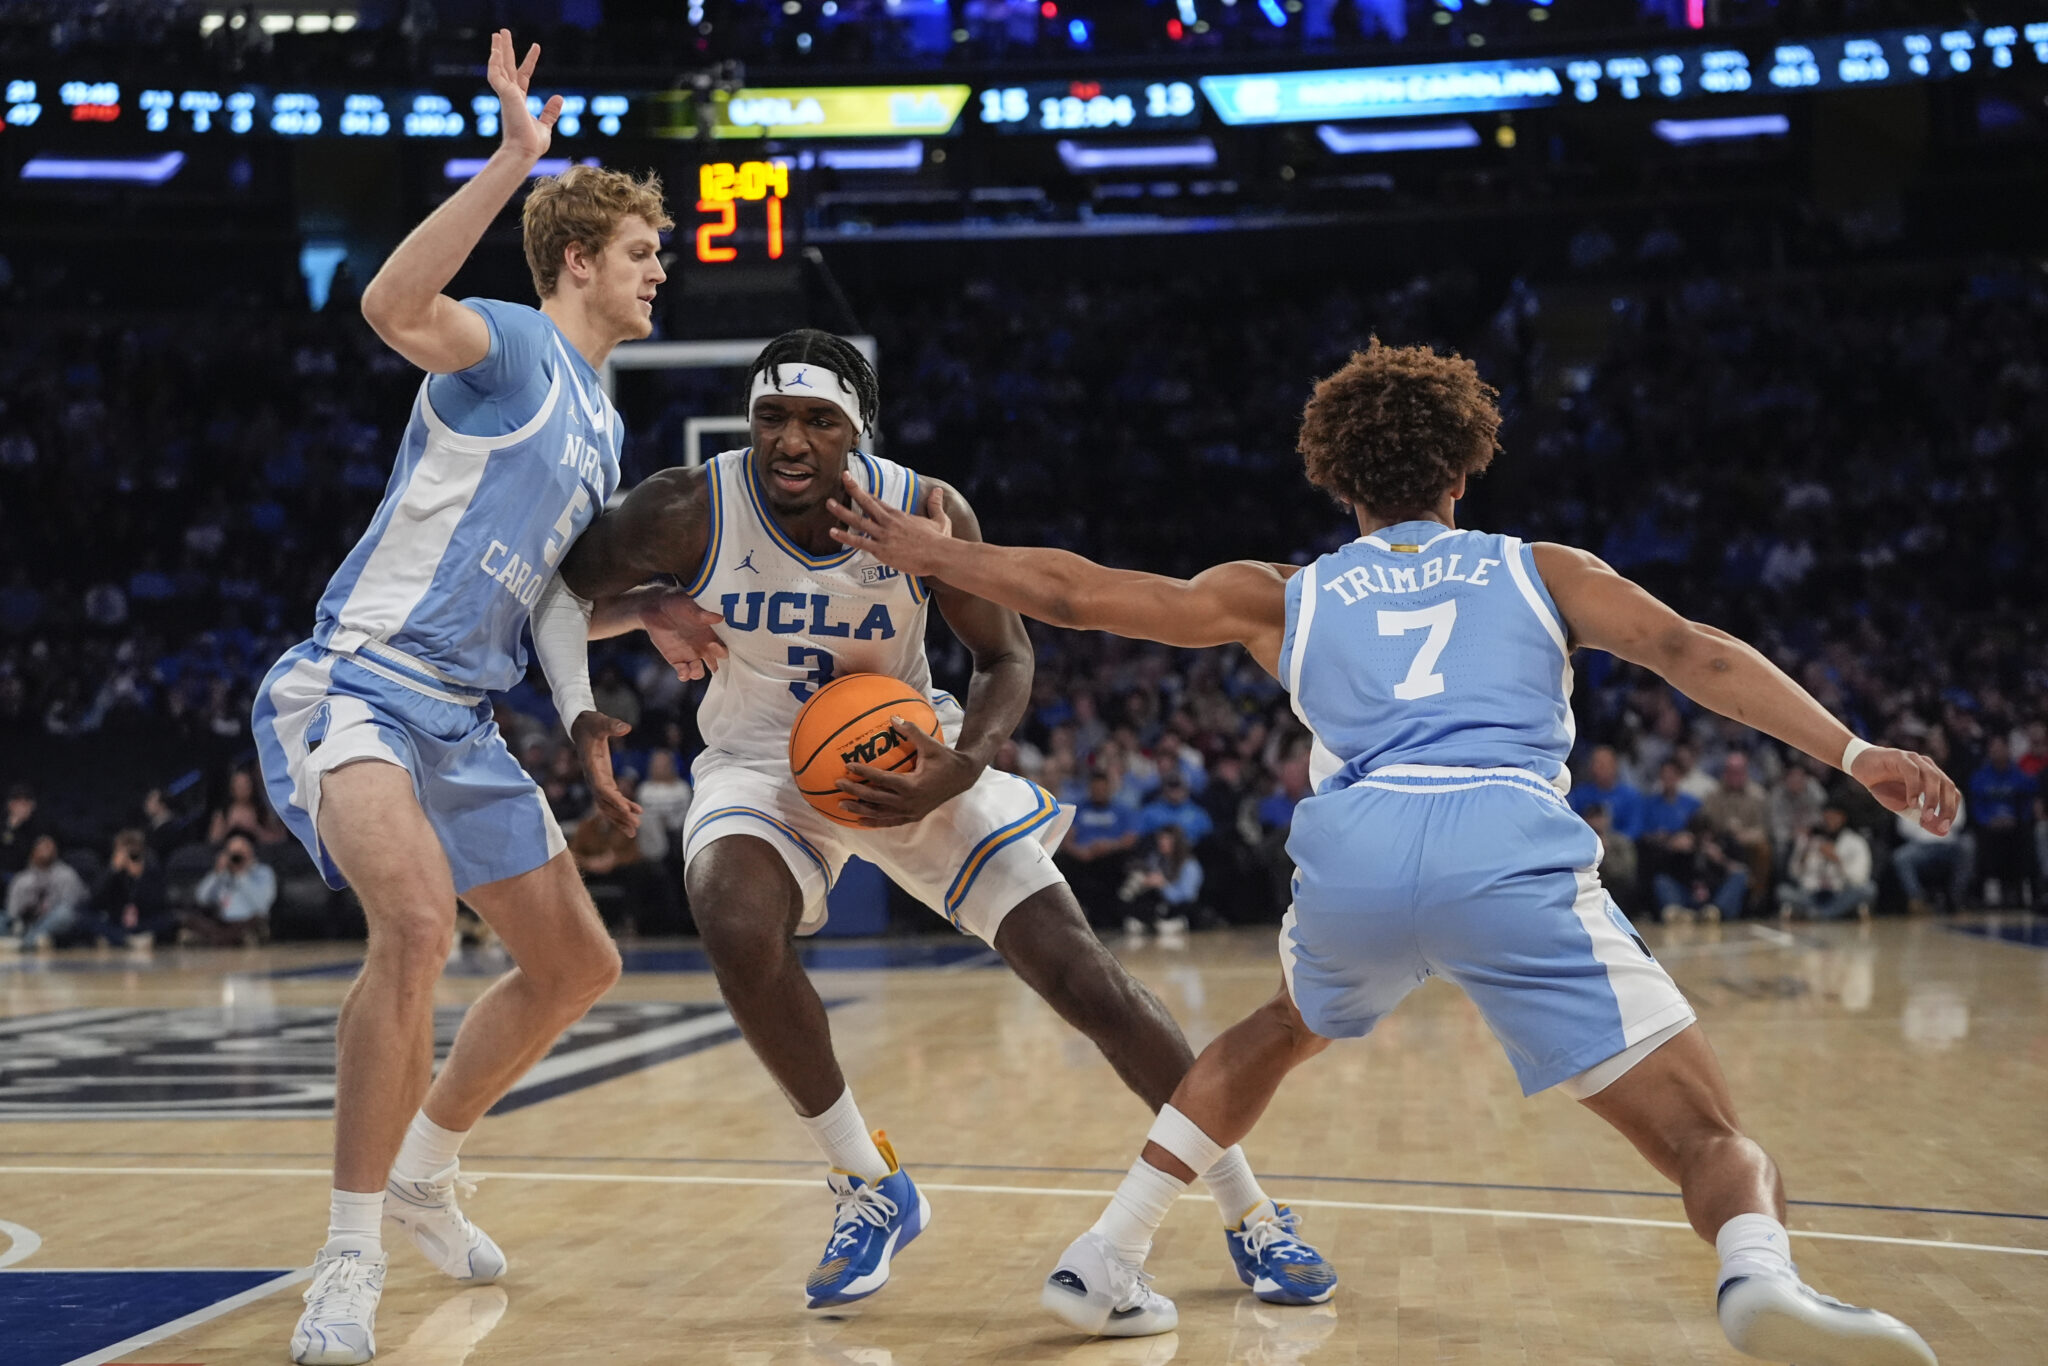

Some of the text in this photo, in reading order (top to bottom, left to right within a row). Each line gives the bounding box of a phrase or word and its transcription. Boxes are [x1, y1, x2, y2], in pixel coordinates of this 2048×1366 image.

[700, 161, 788, 200] 12:04
[696, 196, 783, 262] 21
[480, 539, 546, 608] CARO
[1321, 554, 1500, 606] TRIMBLE
[720, 591, 896, 640] UCLA
[787, 646, 835, 704] 3
[1376, 598, 1457, 701] 7
